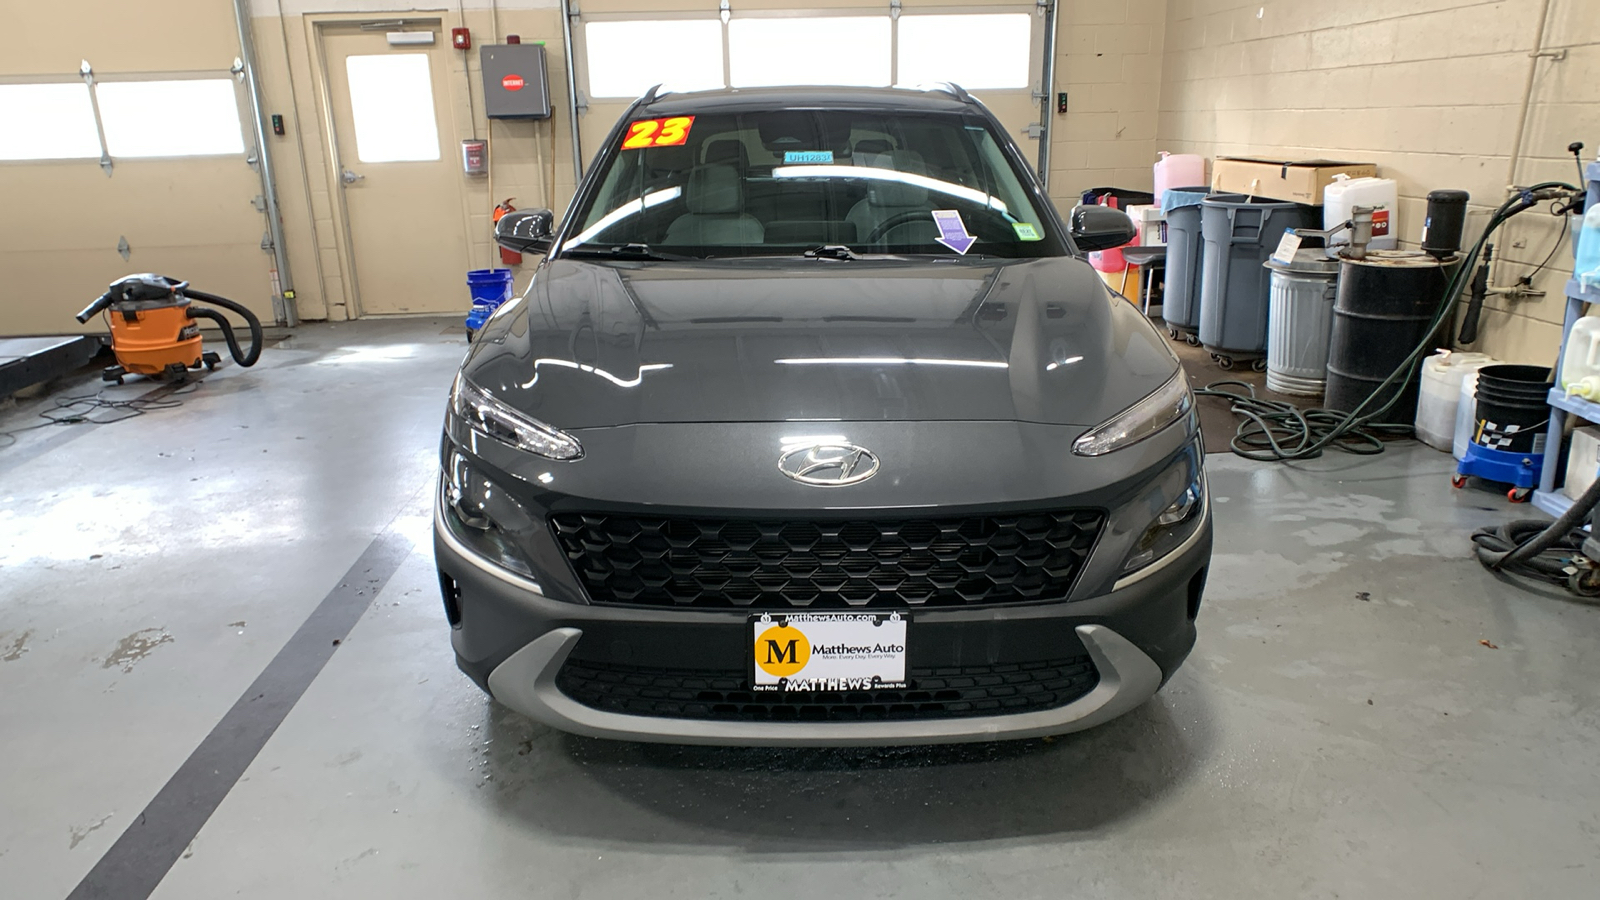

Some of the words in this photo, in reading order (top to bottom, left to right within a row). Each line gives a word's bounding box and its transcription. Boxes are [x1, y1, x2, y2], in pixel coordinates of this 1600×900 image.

[624, 117, 690, 147] 23
[785, 613, 877, 622] MatthewsAuto.com
[763, 639, 800, 664] M
[812, 643, 872, 655] Matthews
[872, 642, 904, 653] Auto
[784, 677, 872, 692] MATTHEWS
